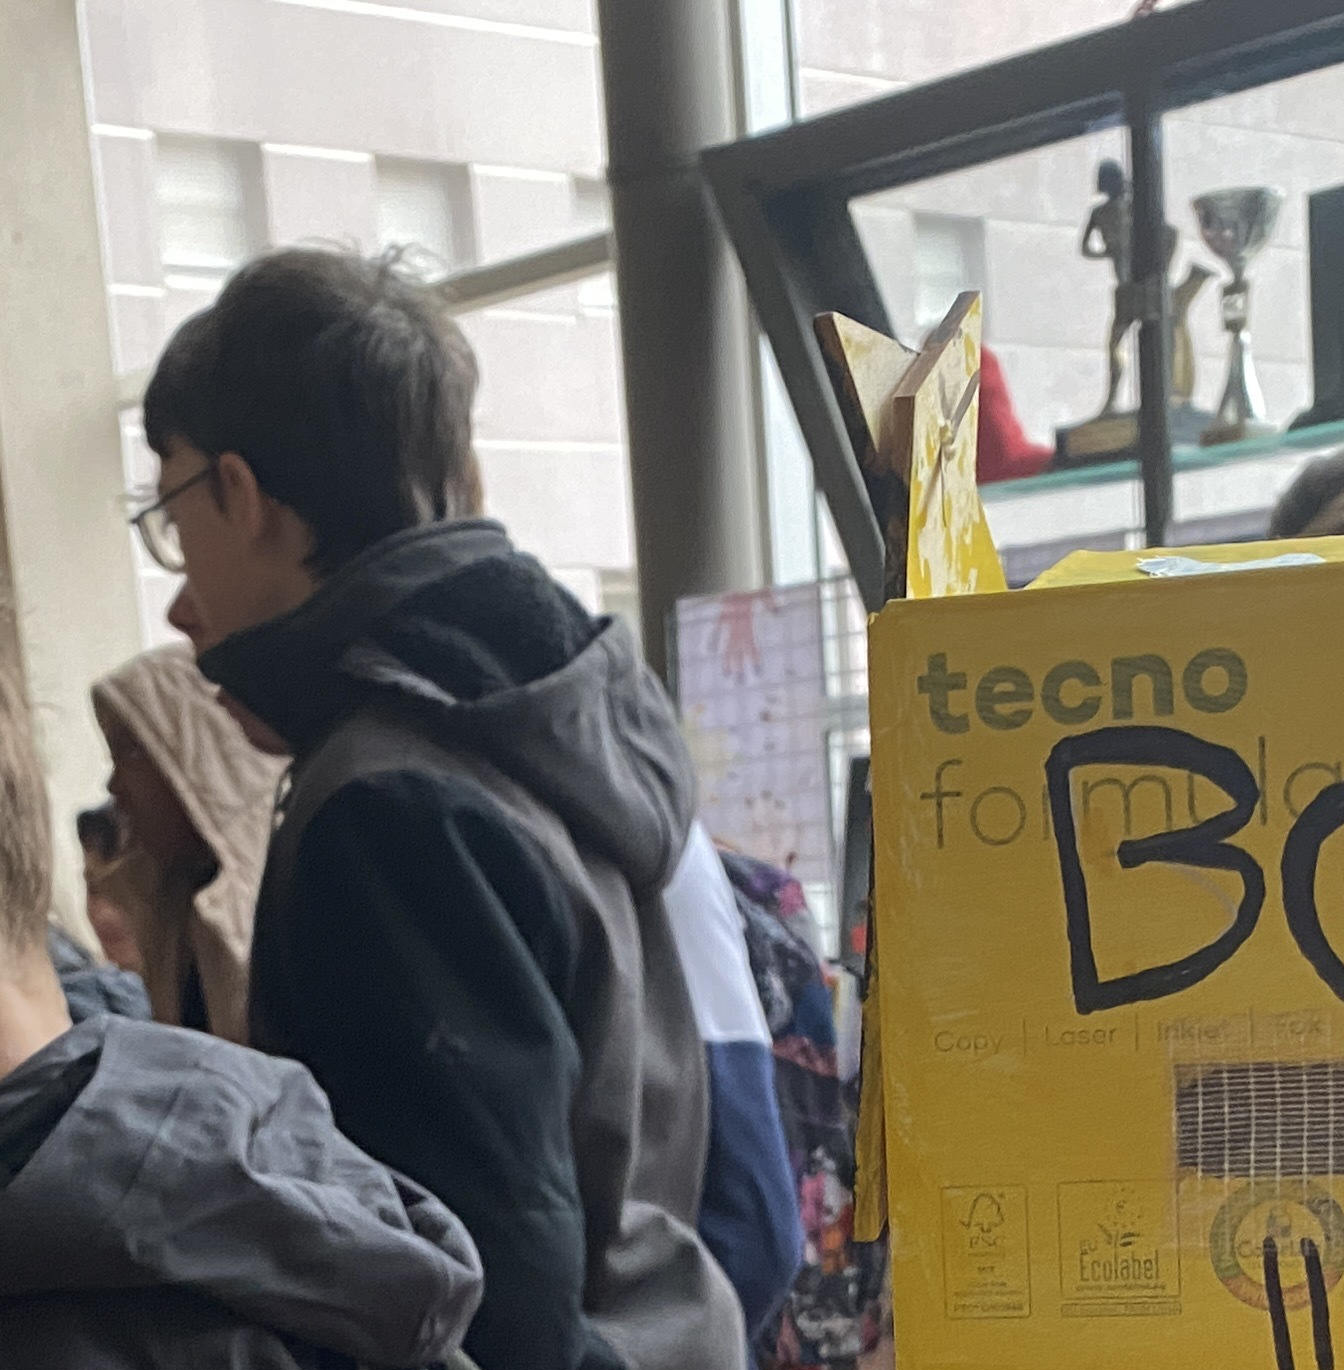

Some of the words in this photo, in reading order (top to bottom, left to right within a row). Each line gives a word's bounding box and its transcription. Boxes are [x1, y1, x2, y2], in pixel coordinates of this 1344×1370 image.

[918, 647, 1248, 735] tecno
[933, 1029, 1002, 1055] Copy
[1044, 1023, 1116, 1046] Laser
[1079, 1249, 1160, 1282] Ecolabel
